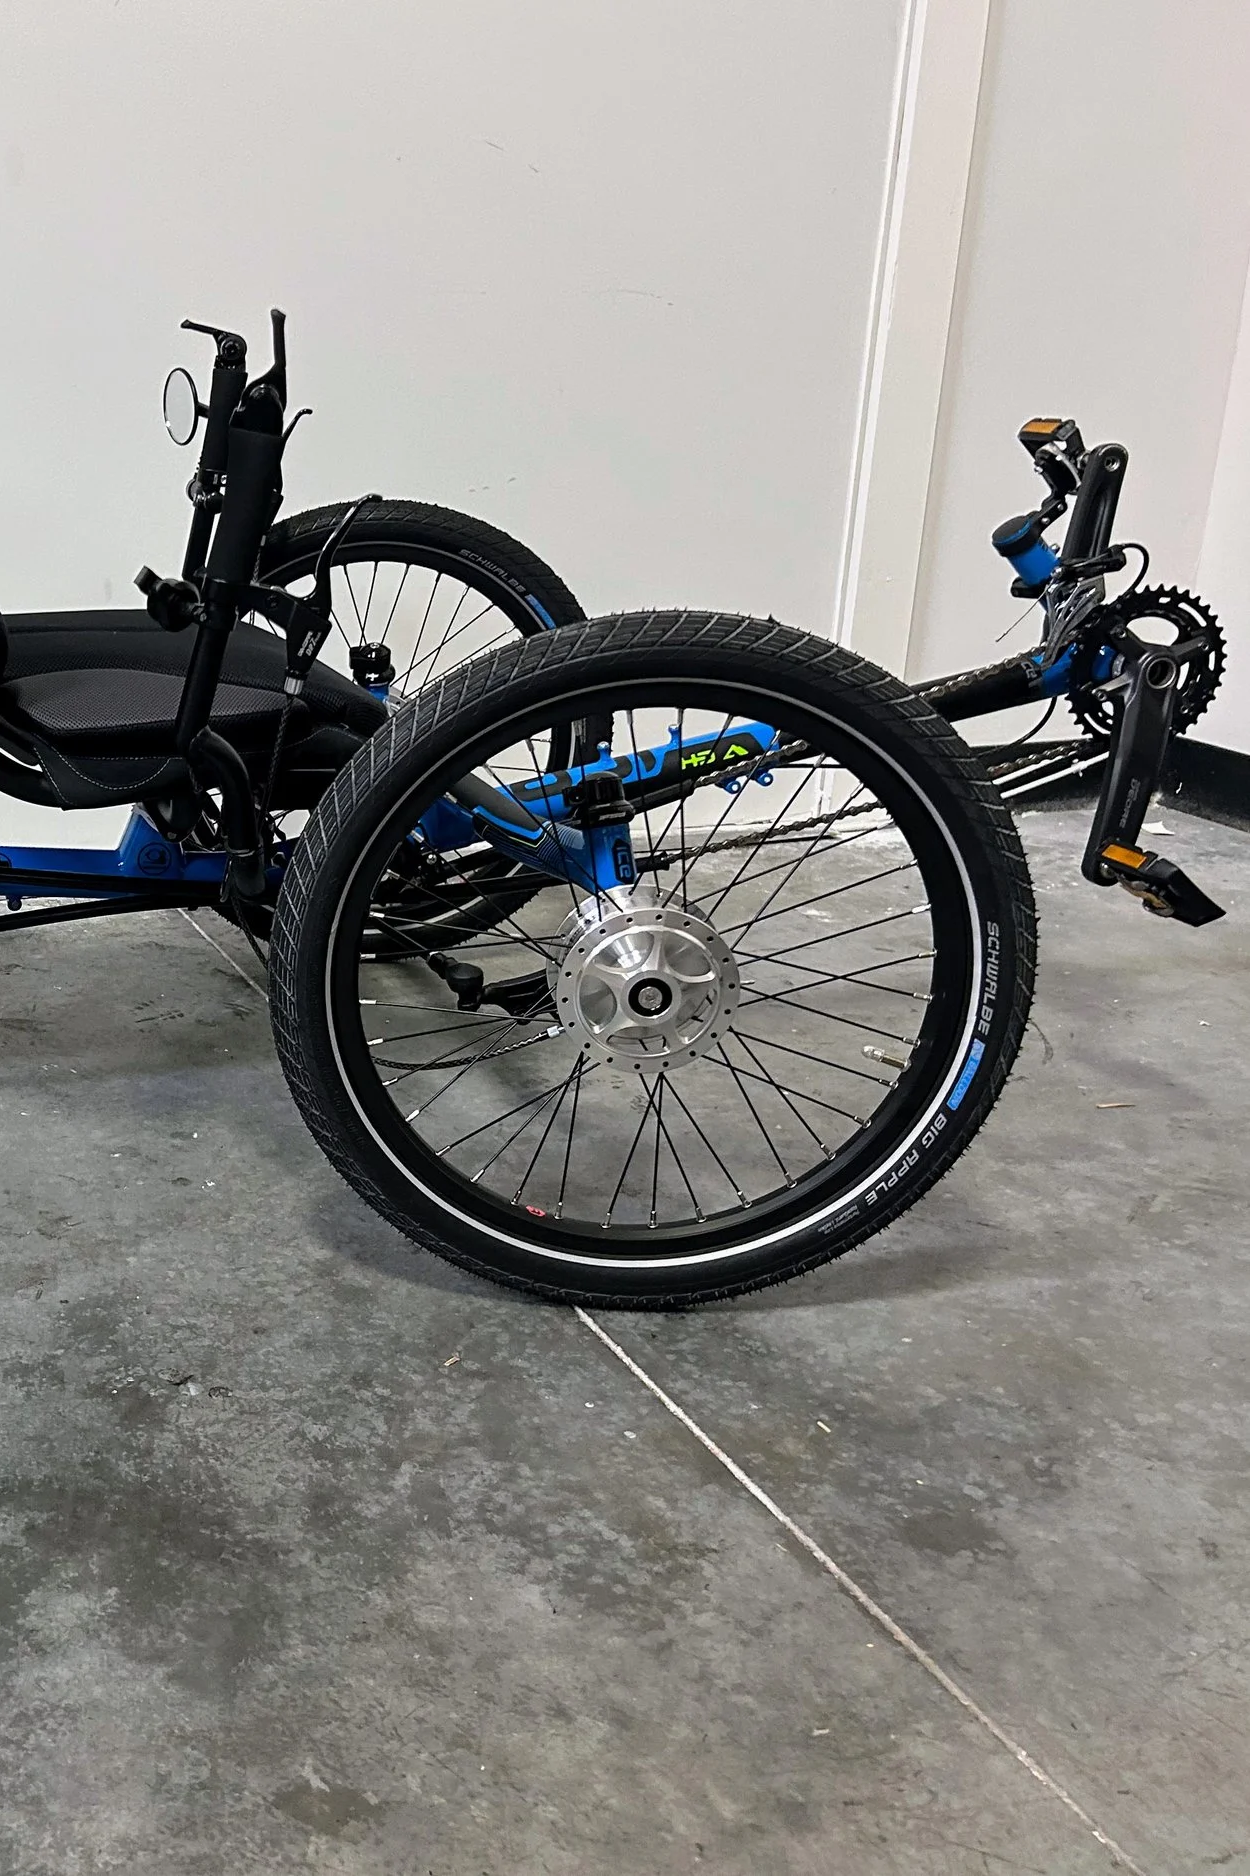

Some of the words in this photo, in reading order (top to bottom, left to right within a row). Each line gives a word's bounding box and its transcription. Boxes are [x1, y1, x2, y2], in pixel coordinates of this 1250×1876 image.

[977, 920, 1000, 1036] SCHWALBE
[920, 1113, 948, 1149] BIG
[865, 1149, 920, 1206] APPLE
